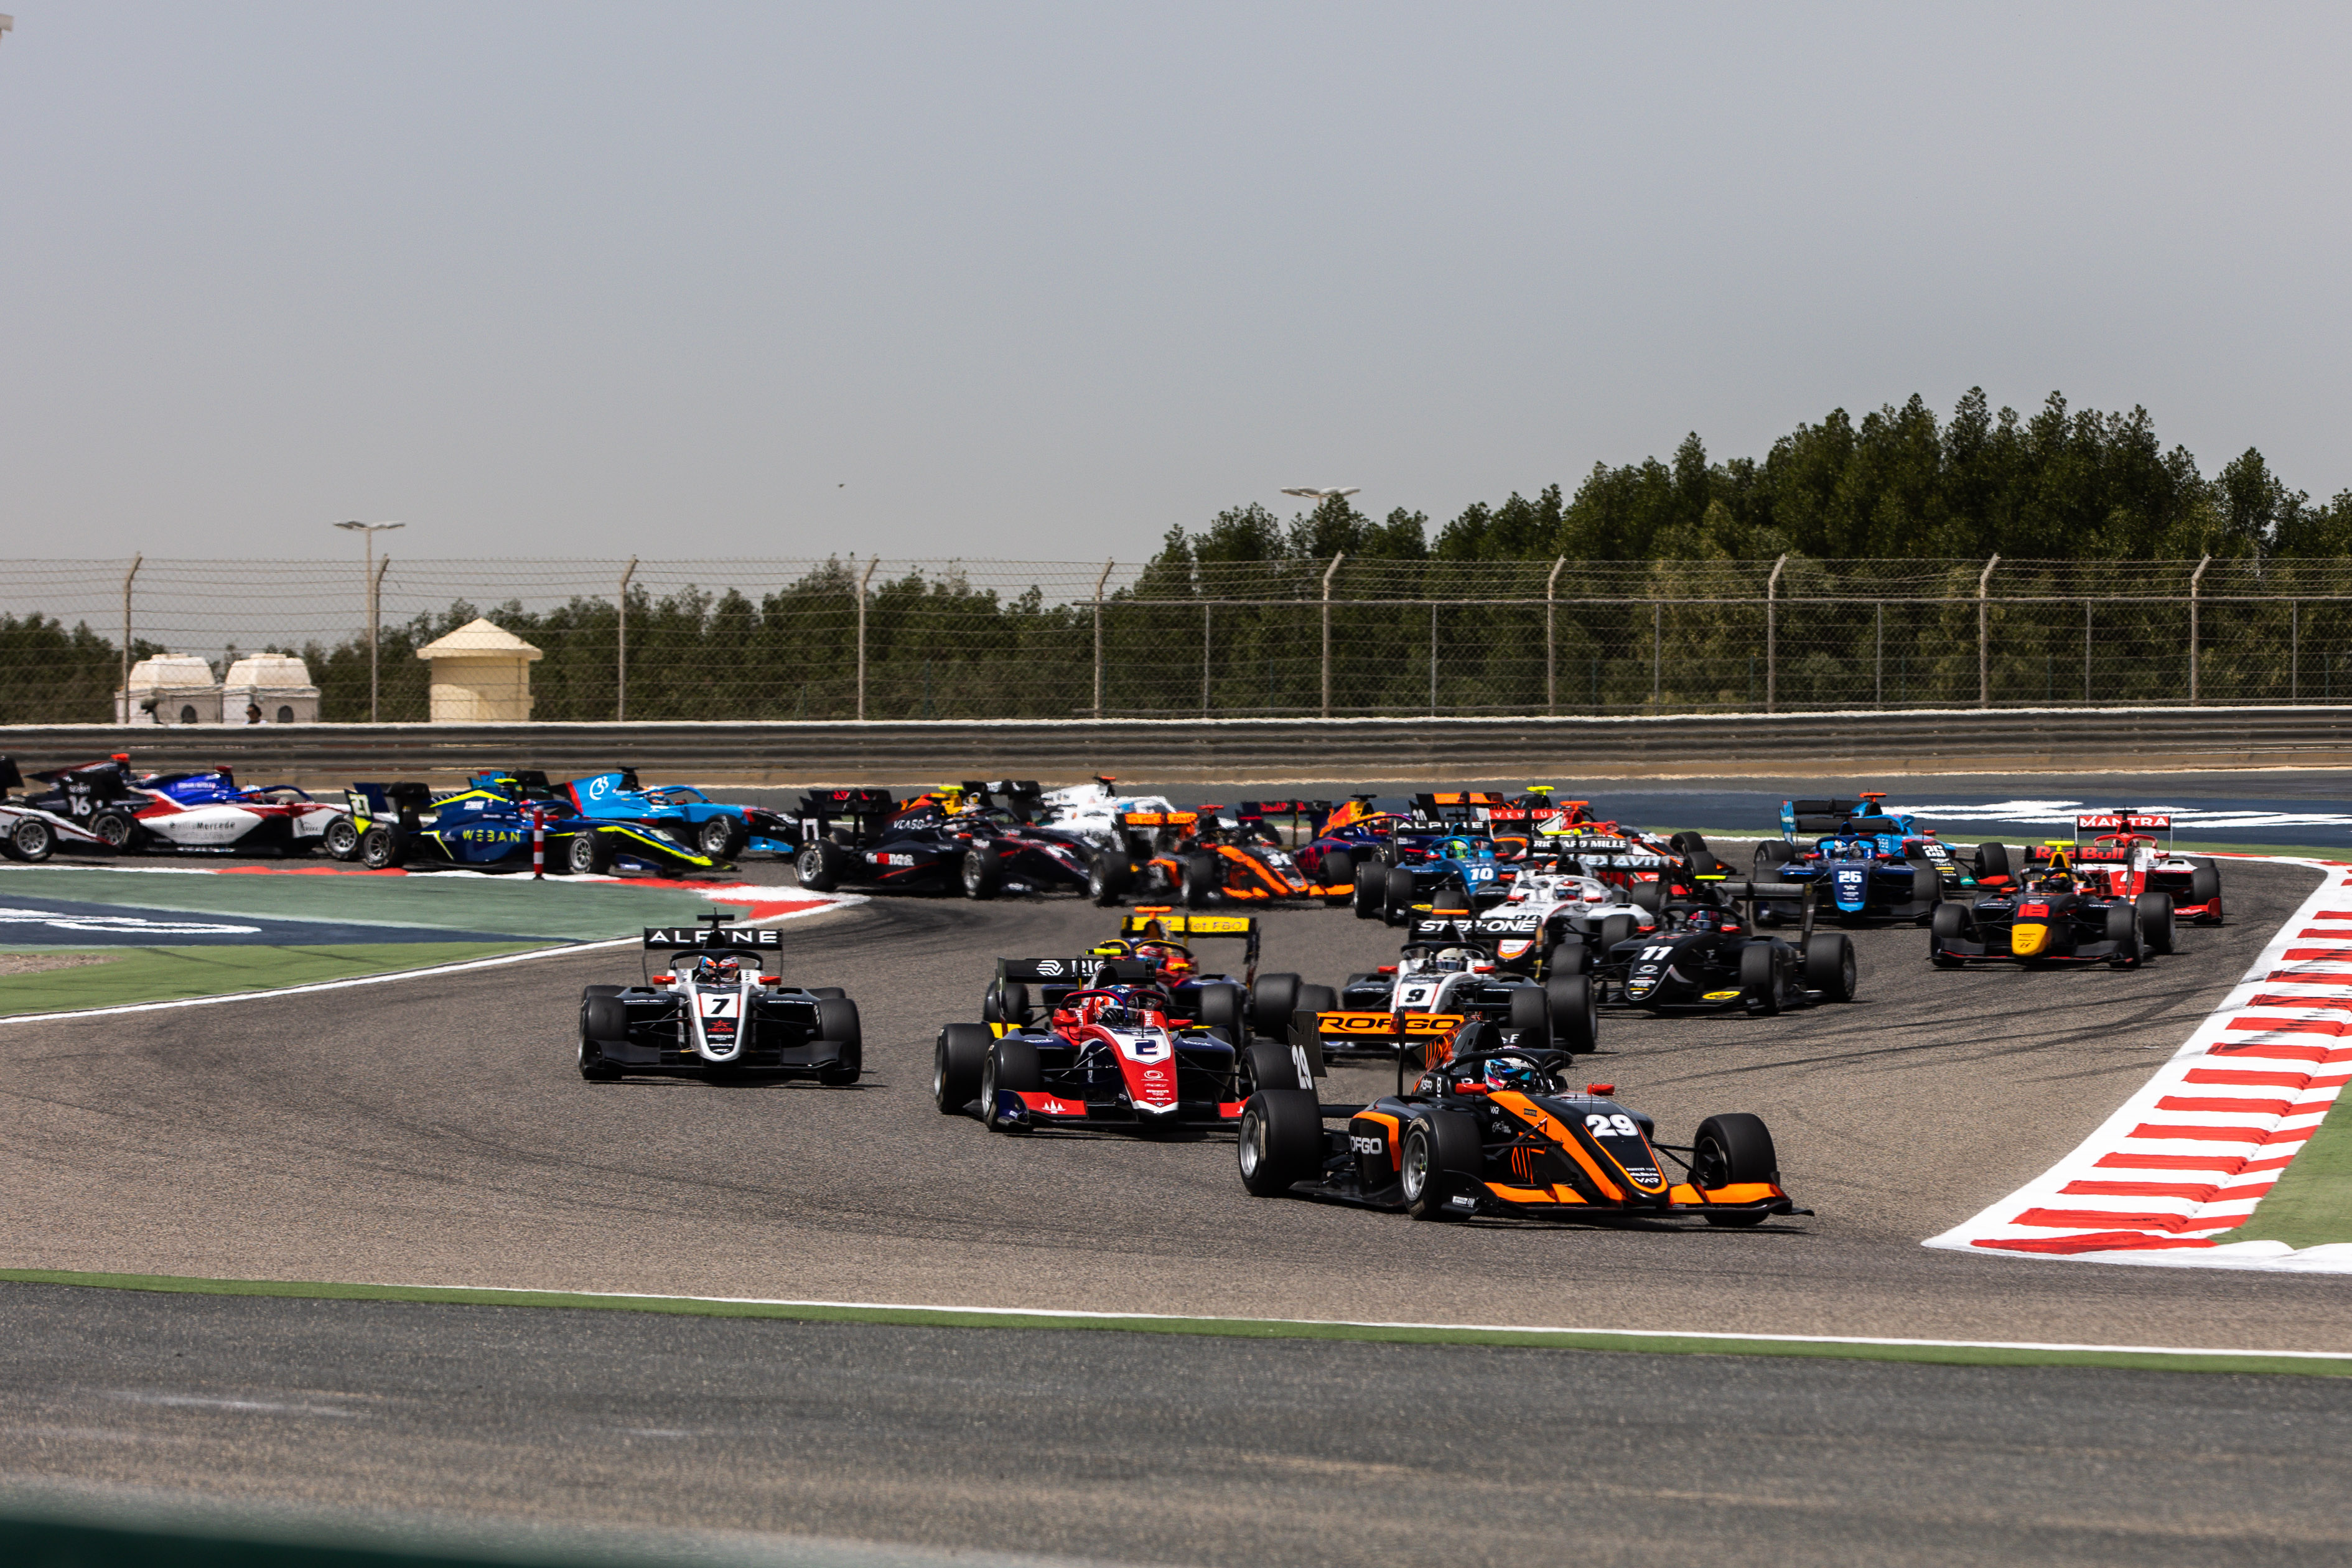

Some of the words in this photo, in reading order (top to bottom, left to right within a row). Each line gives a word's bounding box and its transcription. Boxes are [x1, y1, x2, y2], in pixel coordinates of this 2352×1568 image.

[68, 795, 91, 816] 16
[348, 794, 371, 817] 27
[2079, 816, 2168, 827] MANTRA
[1590, 840, 1627, 848] MILLE
[1922, 845, 1946, 857] 25
[2035, 846, 2076, 859] Rd
[2082, 847, 2124, 859] Bull
[1470, 868, 1493, 880] 10
[1838, 871, 1862, 883] 26
[2017, 903, 2050, 918] 18
[649, 930, 777, 943] ALPNE
[1640, 946, 1674, 960] 11
[1404, 988, 1426, 1002] 9
[711, 999, 730, 1015] 7
[1134, 1039, 1159, 1056] 2
[1291, 1045, 1313, 1090] 29
[1490, 1106, 1500, 1115] VAR
[1585, 1114, 1639, 1137] 29
